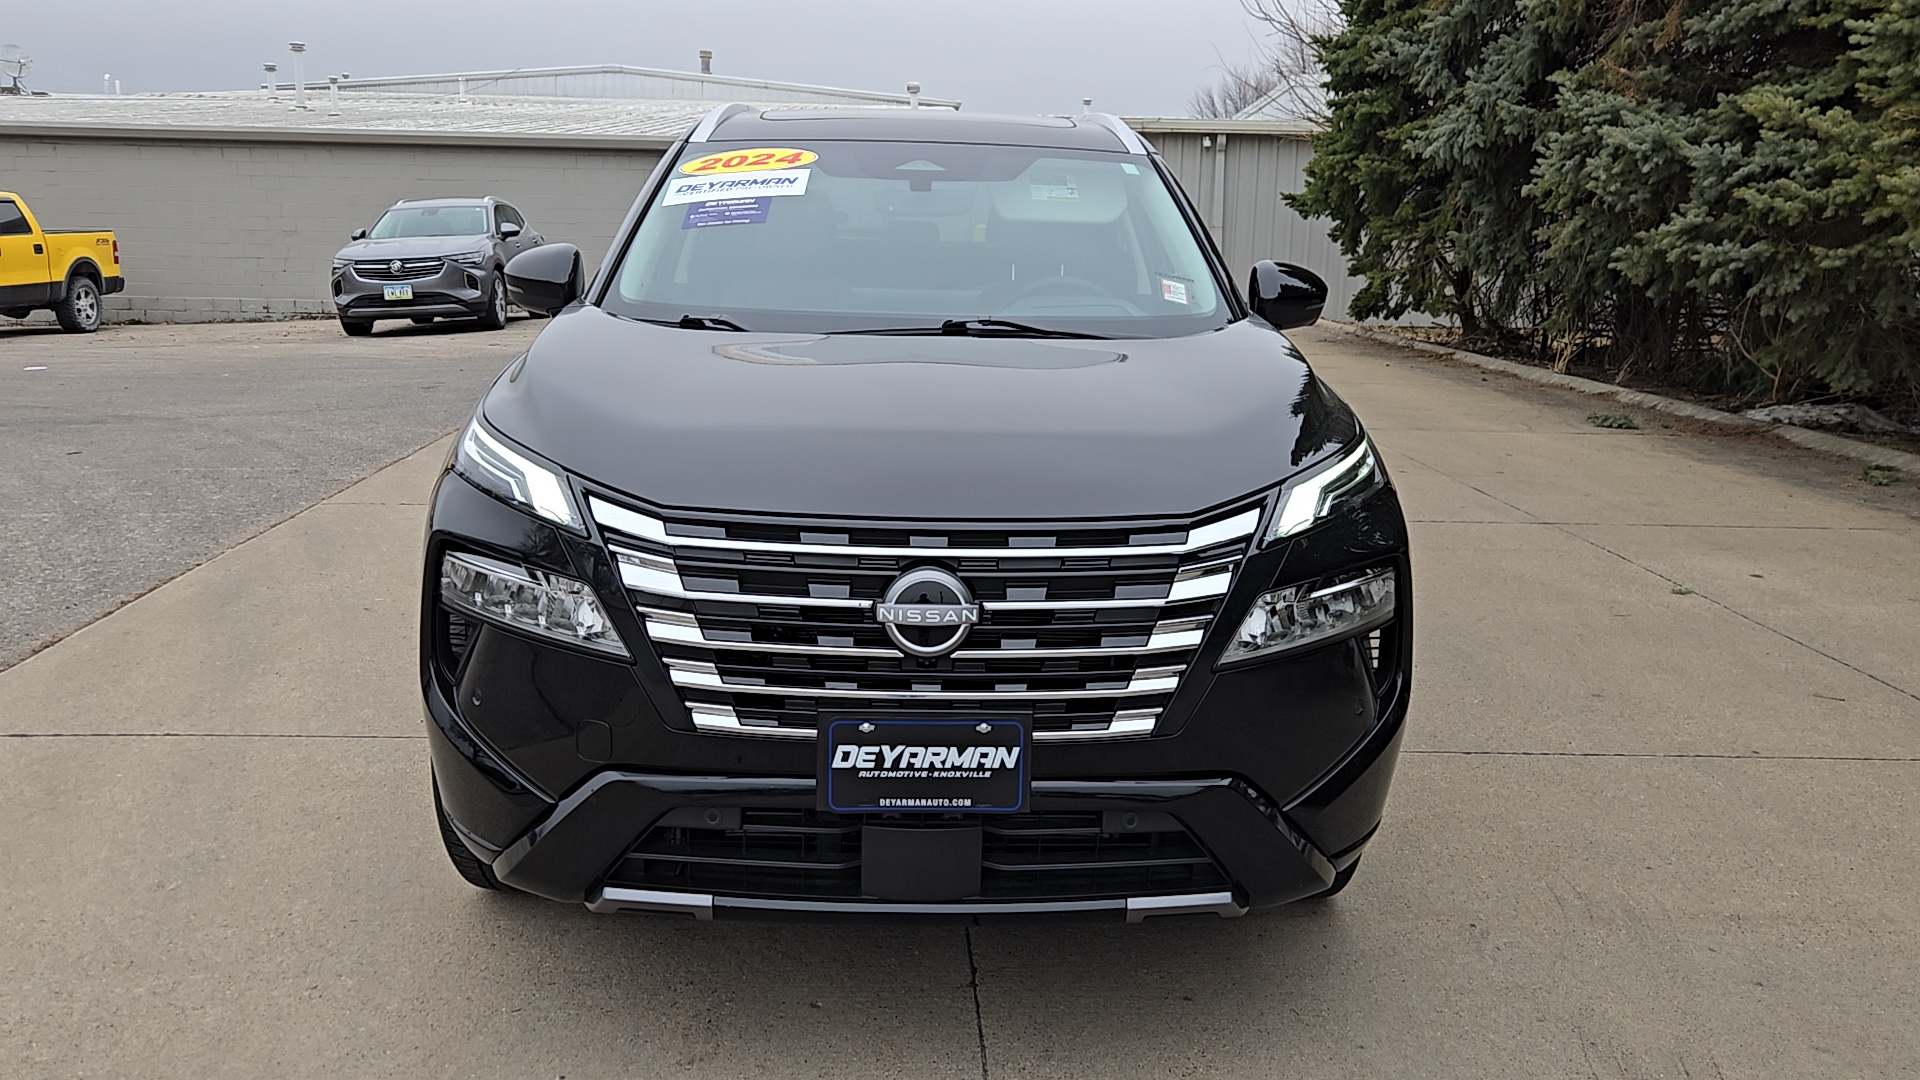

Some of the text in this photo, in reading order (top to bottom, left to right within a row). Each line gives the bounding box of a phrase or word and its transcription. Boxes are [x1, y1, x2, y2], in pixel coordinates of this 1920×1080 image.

[691, 151, 804, 172] 2024
[674, 176, 800, 194] DEYARMAN
[682, 186, 733, 196] CERTIFIED
[879, 607, 978, 623] NISSAN
[831, 745, 1021, 769] DEYARMAN
[879, 798, 972, 807] DEYARMANAUTO.COM
